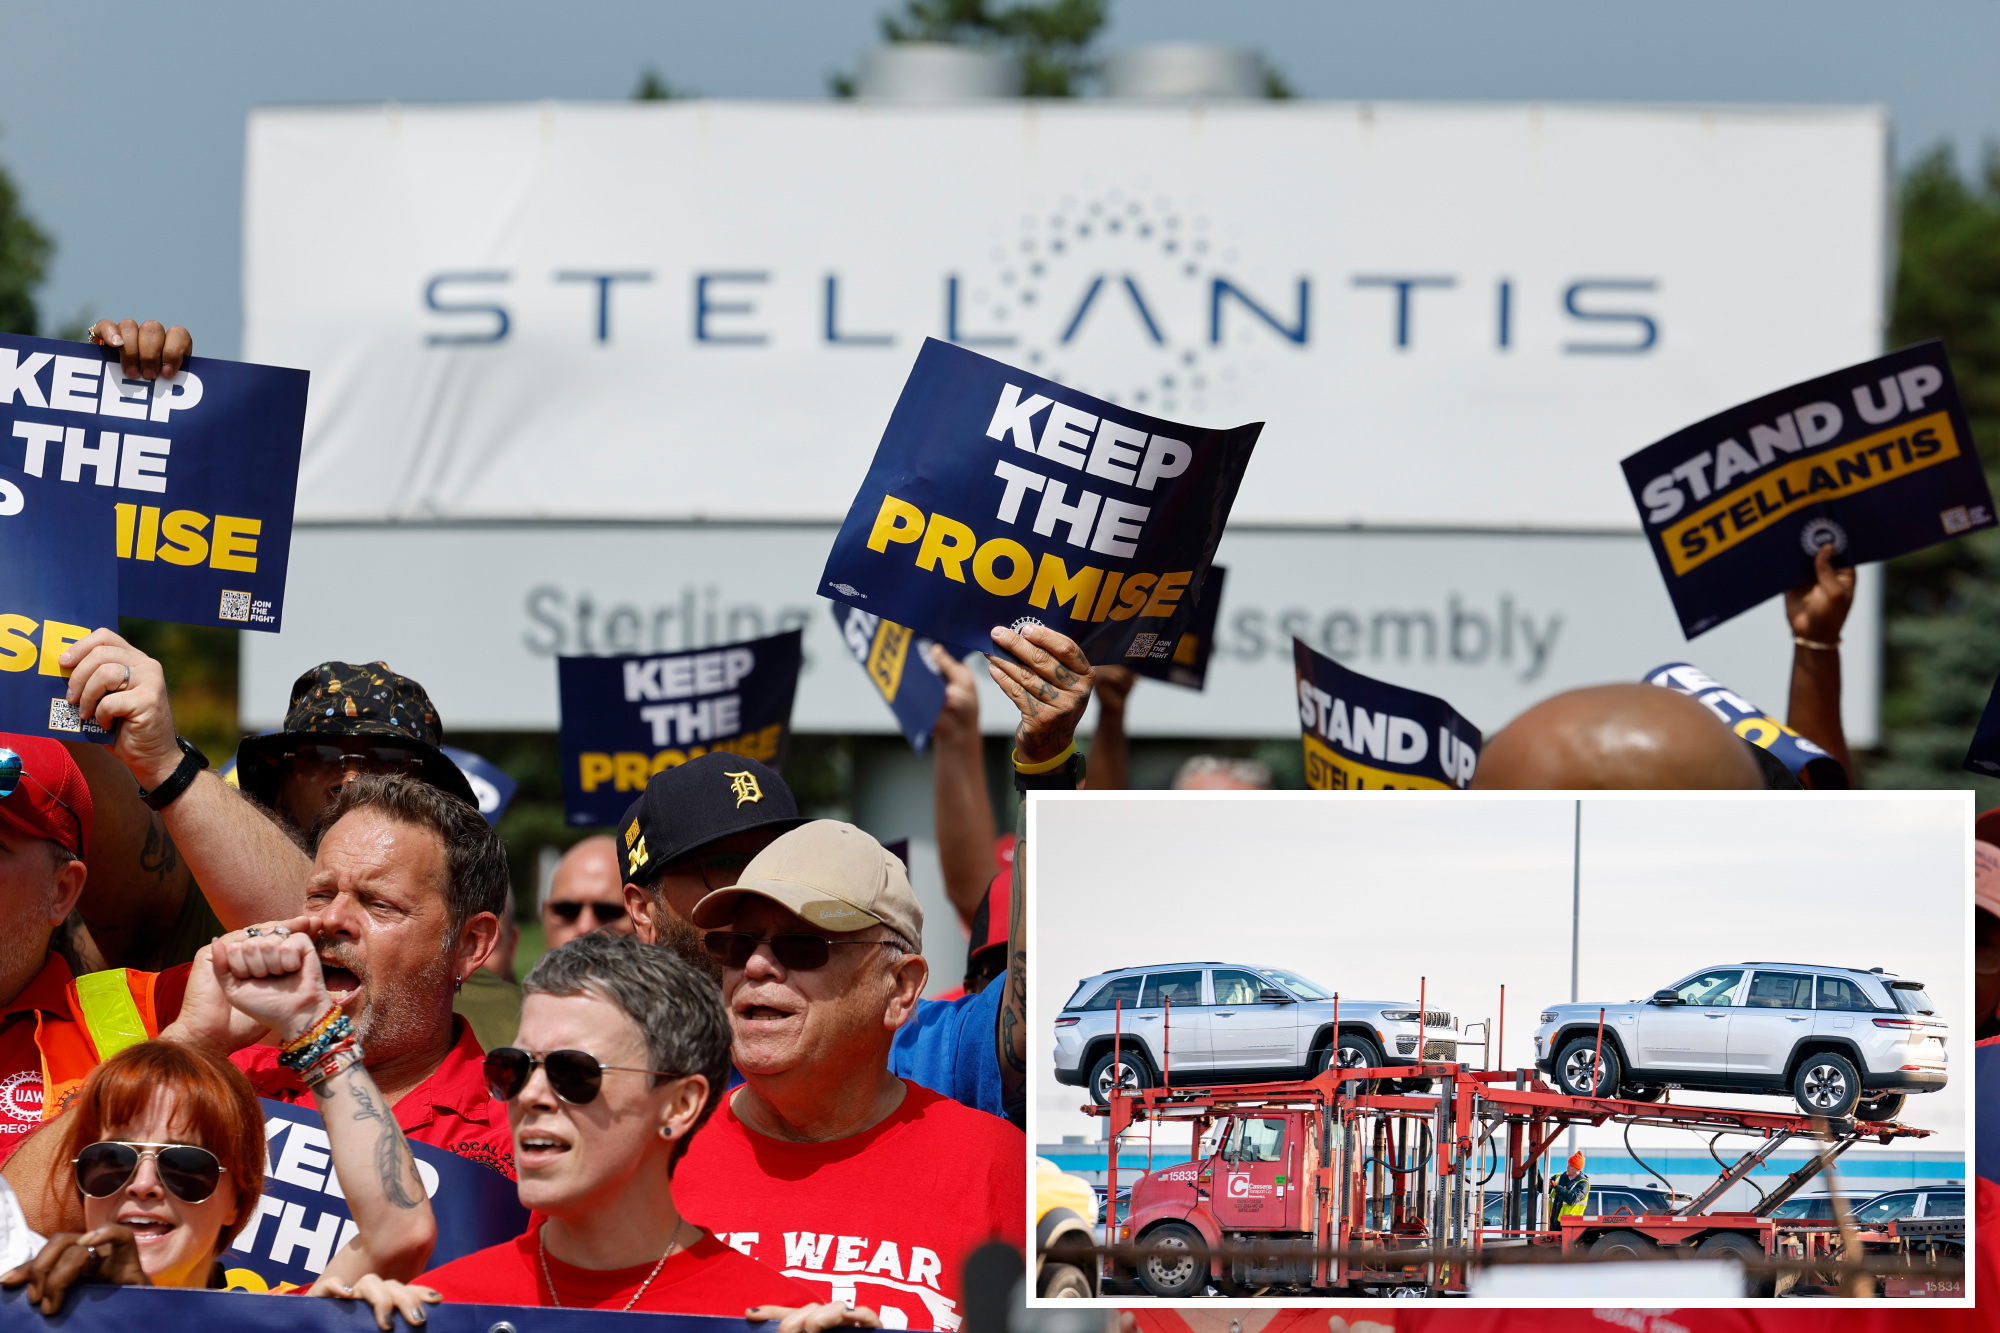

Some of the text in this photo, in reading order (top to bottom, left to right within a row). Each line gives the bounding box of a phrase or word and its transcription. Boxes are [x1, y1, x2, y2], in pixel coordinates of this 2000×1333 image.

[423, 269, 1662, 357] STELLANTIS
[0, 348, 204, 423] KEEP
[11, 420, 172, 494] THE
[986, 382, 1193, 491] KEEP
[1641, 365, 1943, 524] STAND UP
[994, 459, 1151, 559] THE
[1679, 427, 1942, 560] STELLANTIS
[866, 494, 1193, 623] PROMISE
[250, 614, 275, 623] FIGHT
[251, 600, 272, 608] JOIN
[251, 607, 268, 615] THE
[1212, 589, 1564, 684] ssembly
[622, 647, 756, 702] KEEP
[640, 694, 742, 747] THE
[1299, 679, 1429, 765] STAND
[1438, 726, 1477, 790] UP
[15, 1088, 44, 1104] UAW
[450, 1141, 498, 1157] LOCAL
[1169, 1170, 1198, 1182] 15833
[782, 1231, 942, 1291] WEAR
[1925, 1281, 1961, 1292] 15834
